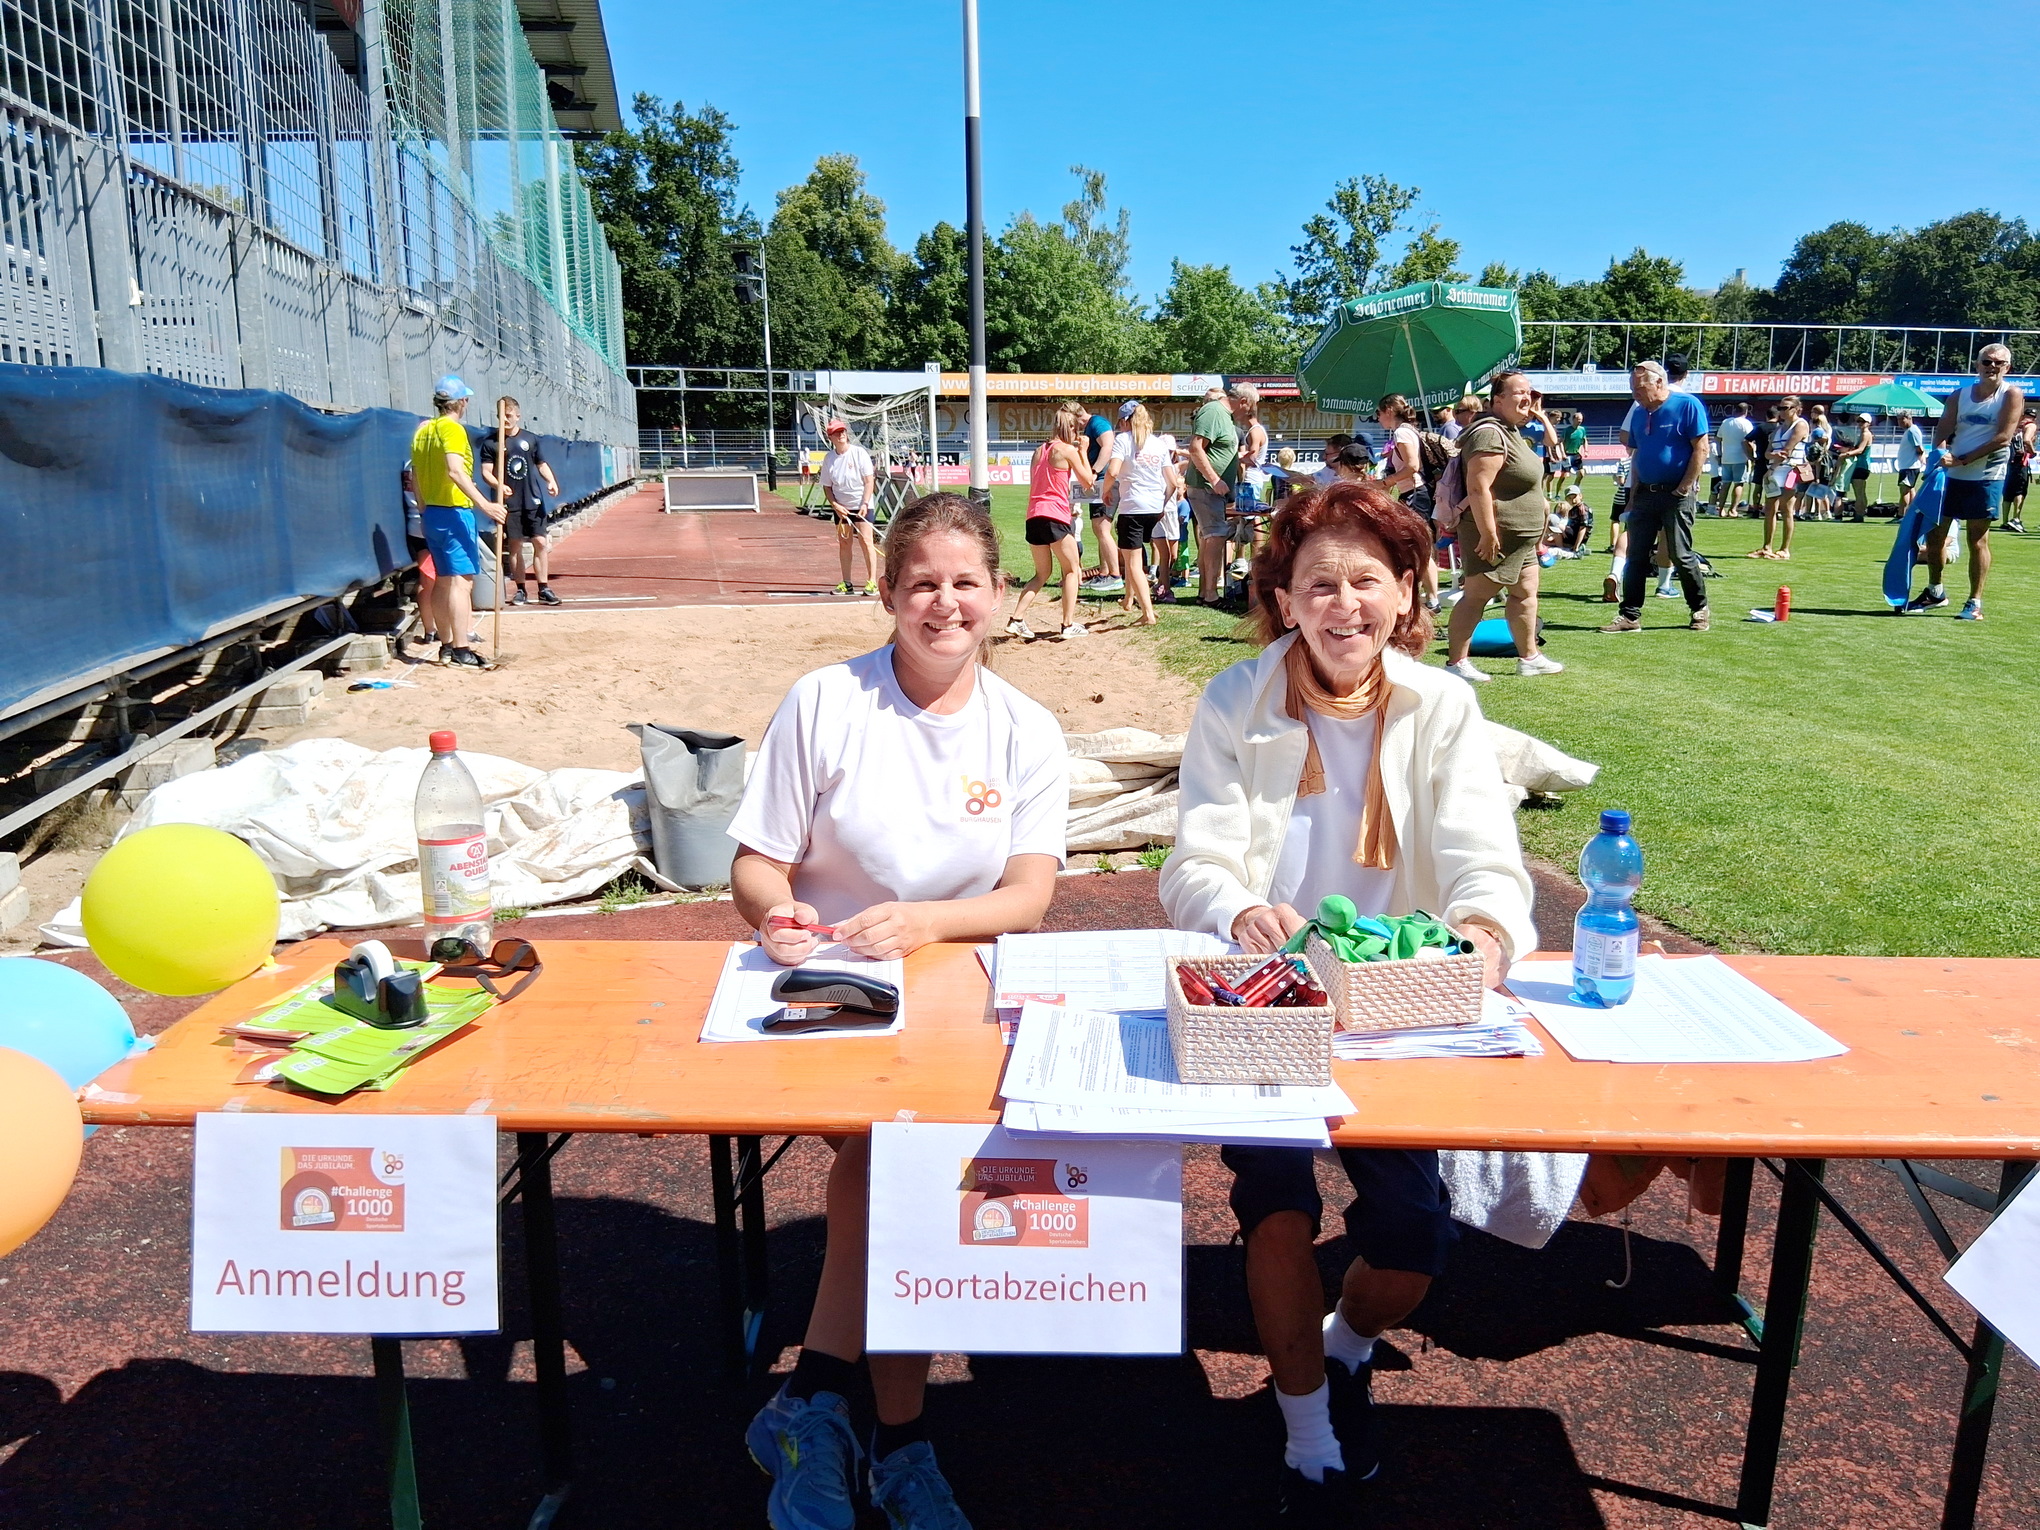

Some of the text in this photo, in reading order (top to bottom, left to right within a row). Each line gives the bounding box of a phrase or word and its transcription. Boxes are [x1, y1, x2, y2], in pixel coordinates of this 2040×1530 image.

[1353, 290, 1426, 319] Schönramer
[1446, 287, 1508, 307] Schönramer
[927, 363, 939, 373] K1
[1584, 365, 1595, 373] K3
[942, 377, 1171, 394] wwcampus-burghausen.de
[302, 1154, 316, 1162] DIE
[982, 1166, 997, 1174] DIE
[331, 1186, 393, 1199] #Challenge
[347, 1199, 394, 1216] 1000
[1013, 1199, 1076, 1213] #Challenge
[1030, 1213, 1077, 1231] 1000
[216, 1259, 466, 1306] Anmeldung
[894, 1269, 1147, 1305] Sportabzeichen
